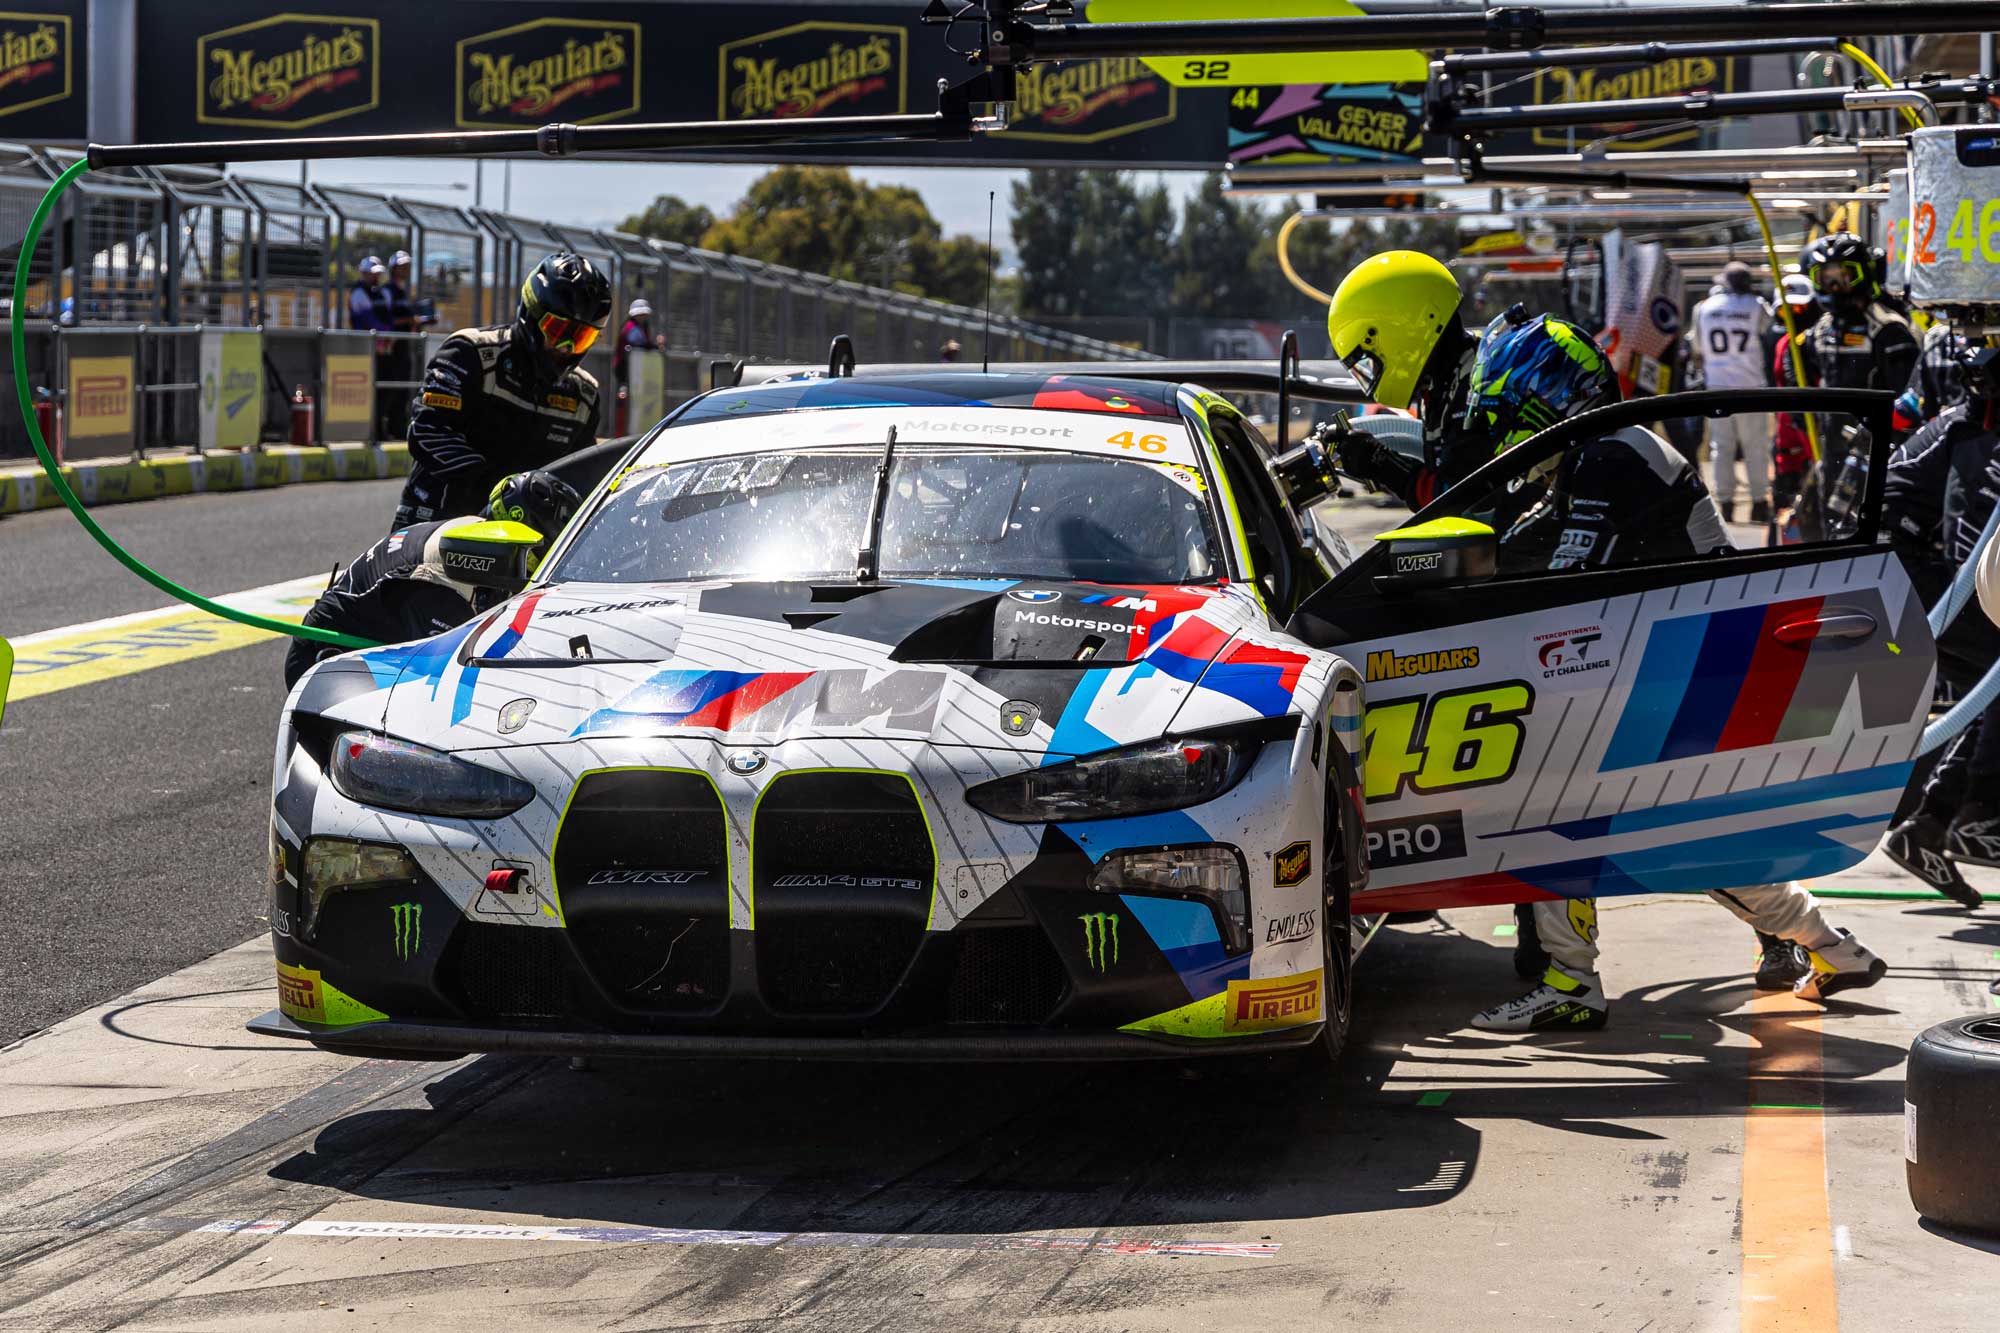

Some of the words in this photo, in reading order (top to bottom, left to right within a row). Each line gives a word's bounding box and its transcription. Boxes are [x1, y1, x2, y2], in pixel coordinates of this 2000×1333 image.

[0, 24, 58, 71] iar's
[209, 27, 364, 111] Meguiar's
[468, 31, 627, 115] Meguiar's
[732, 35, 892, 118] Meguiar's
[1183, 61, 1230, 80] 32
[1231, 88, 1260, 110] 44
[1338, 105, 1407, 131] GEYER
[1297, 116, 1406, 150] VALMONT
[1946, 198, 2000, 264] 46
[1709, 328, 1750, 353] 07
[903, 419, 1074, 438] Motorsport
[1106, 430, 1168, 454] 46
[446, 552, 495, 571] WRT
[1397, 552, 1442, 572] WRT
[539, 599, 679, 620] SKECHERS
[1015, 610, 1147, 636] Motorsport
[1533, 625, 1601, 642] INTERCONTINENTAL
[1543, 670, 1555, 679] GT
[1557, 659, 1611, 677] CHALLENGE
[1365, 679, 1536, 805] 46
[1367, 824, 1441, 861] PRO
[588, 871, 708, 885] WRT
[860, 877, 921, 890] GT3
[1266, 909, 1316, 943] ENDLESS
[1236, 980, 1317, 1020] PIRELLI
[1507, 1000, 1558, 1022] SKECHERS
[1571, 1009, 1590, 1023] 46
[322, 1225, 536, 1237] Motorsport
